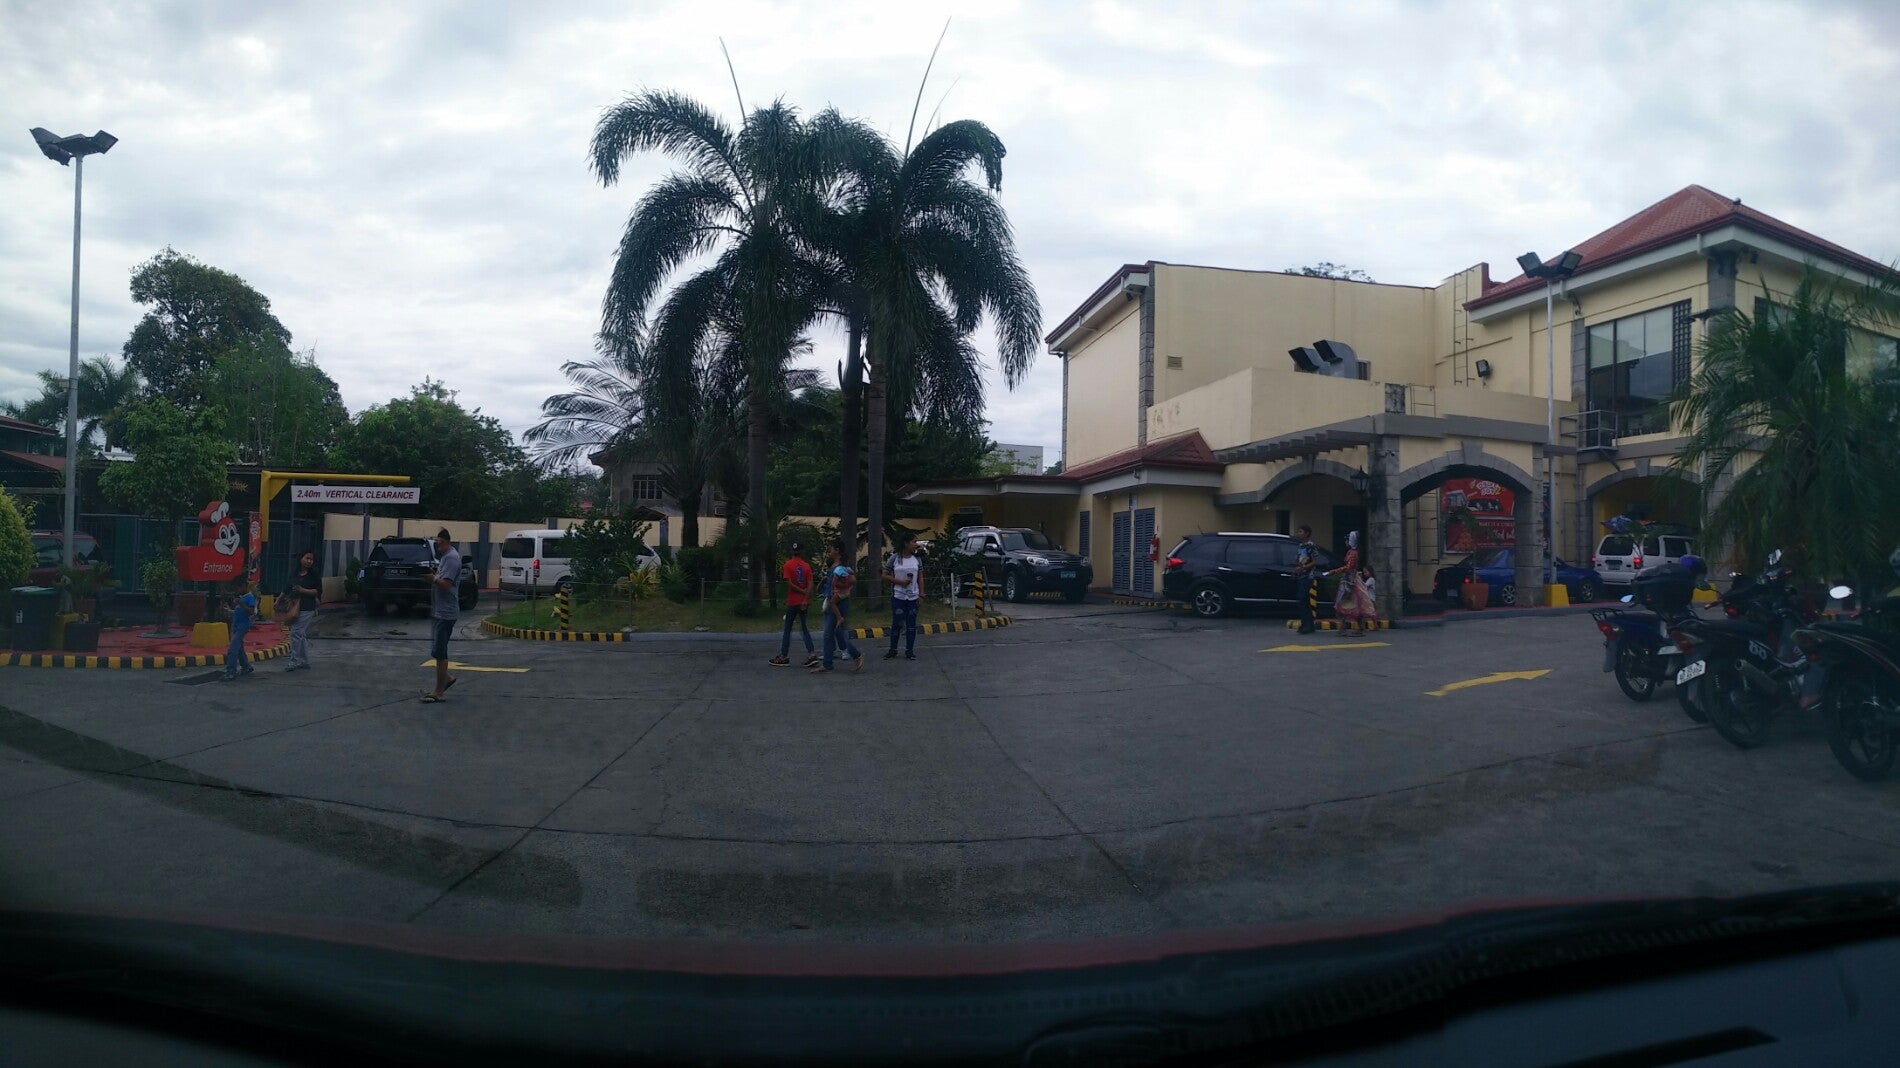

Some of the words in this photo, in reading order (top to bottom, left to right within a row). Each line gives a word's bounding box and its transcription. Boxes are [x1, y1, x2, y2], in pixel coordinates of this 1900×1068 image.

[297, 490, 321, 498] 2.40m
[325, 490, 364, 499] VERTICAL
[365, 490, 415, 500] CLEARANCE
[203, 562, 233, 573] Entrance
